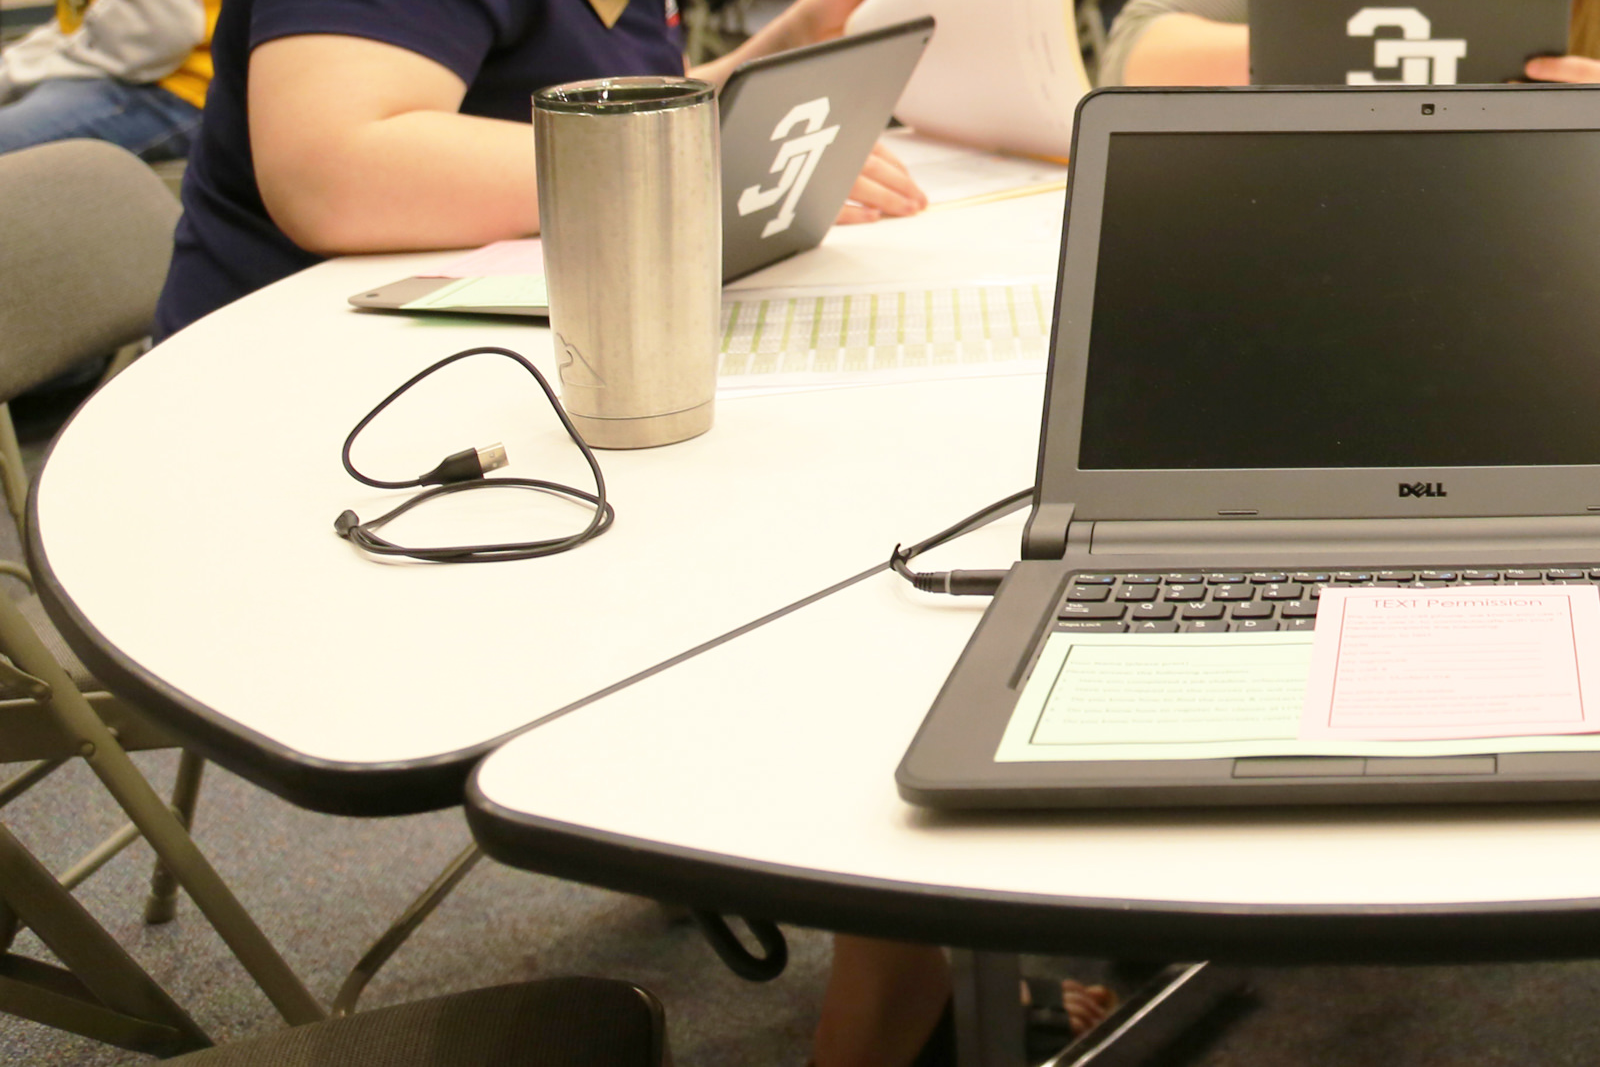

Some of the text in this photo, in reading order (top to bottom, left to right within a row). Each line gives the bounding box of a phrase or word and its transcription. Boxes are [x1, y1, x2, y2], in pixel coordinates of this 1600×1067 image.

[1398, 481, 1448, 498] DELL
[1373, 597, 1543, 609] TEXT Permission
